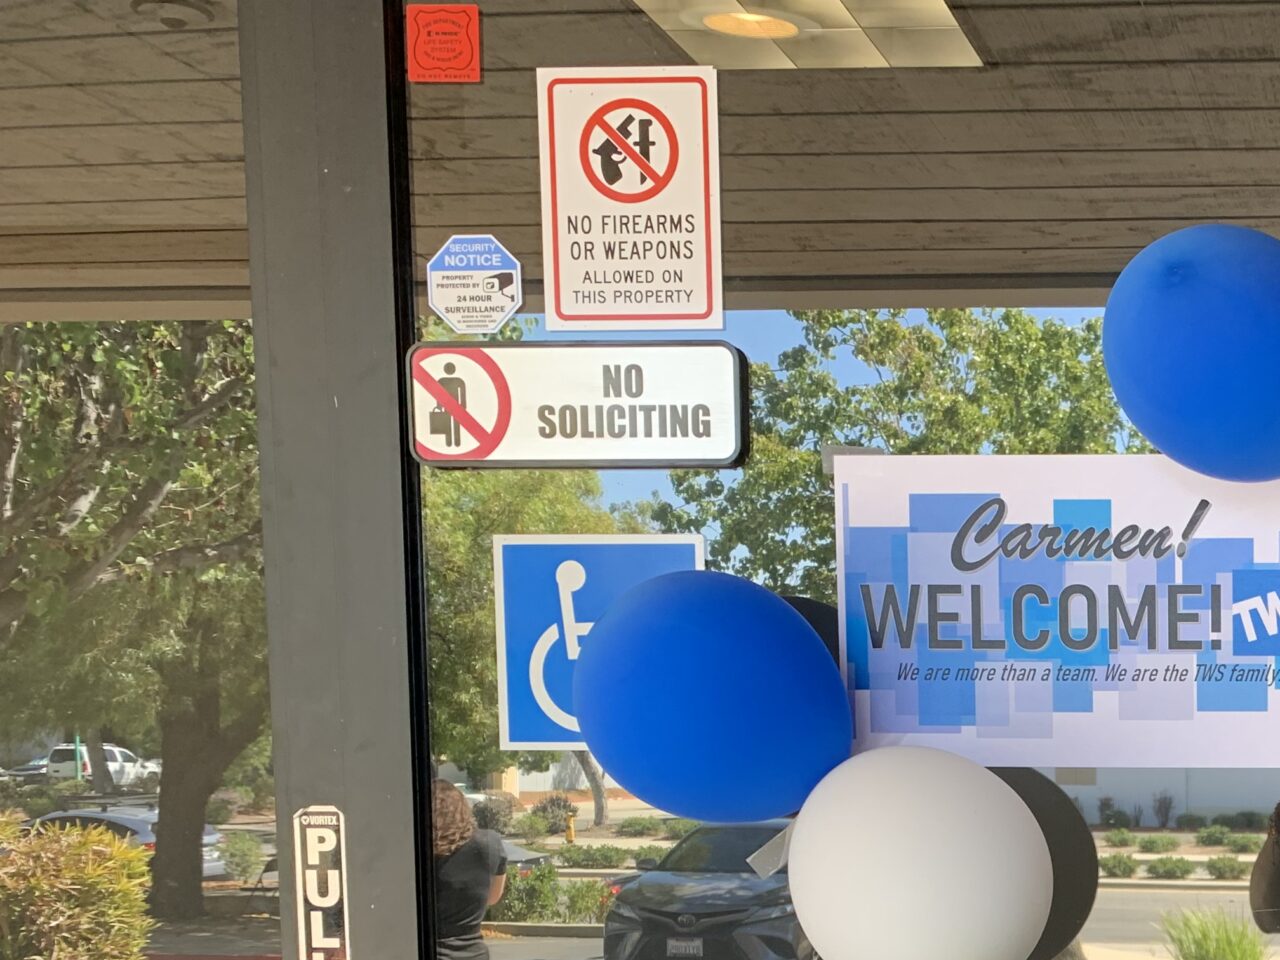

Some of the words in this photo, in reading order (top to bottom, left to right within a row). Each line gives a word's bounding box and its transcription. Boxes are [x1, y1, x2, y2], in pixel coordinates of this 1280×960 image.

[567, 215, 592, 234] NO
[602, 214, 695, 234] FIREARMS
[449, 243, 496, 252] SECURITY
[570, 241, 595, 260] OR
[603, 240, 694, 260] WEAPONS
[444, 254, 502, 266] NOTICE
[582, 270, 655, 284] ALLOWED
[662, 269, 683, 283] ON
[572, 290, 606, 304] THIS
[614, 289, 694, 303] PROPERTY
[444, 306, 506, 314] SURVEILLANCE
[602, 364, 644, 398] NO
[537, 404, 712, 439] SOLICITING
[950, 497, 1212, 572] Carmen!
[858, 583, 1222, 651] WELCOME!
[897, 664, 919, 682] We
[924, 668, 950, 682] are
[955, 668, 996, 682] more
[1000, 664, 1035, 682] than
[1041, 668, 1050, 682] a
[1056, 664, 1098, 682] team.
[1104, 664, 1127, 682] We
[1132, 668, 1158, 682] are
[1163, 664, 1188, 682] the
[1195, 664, 1224, 682] TWS
